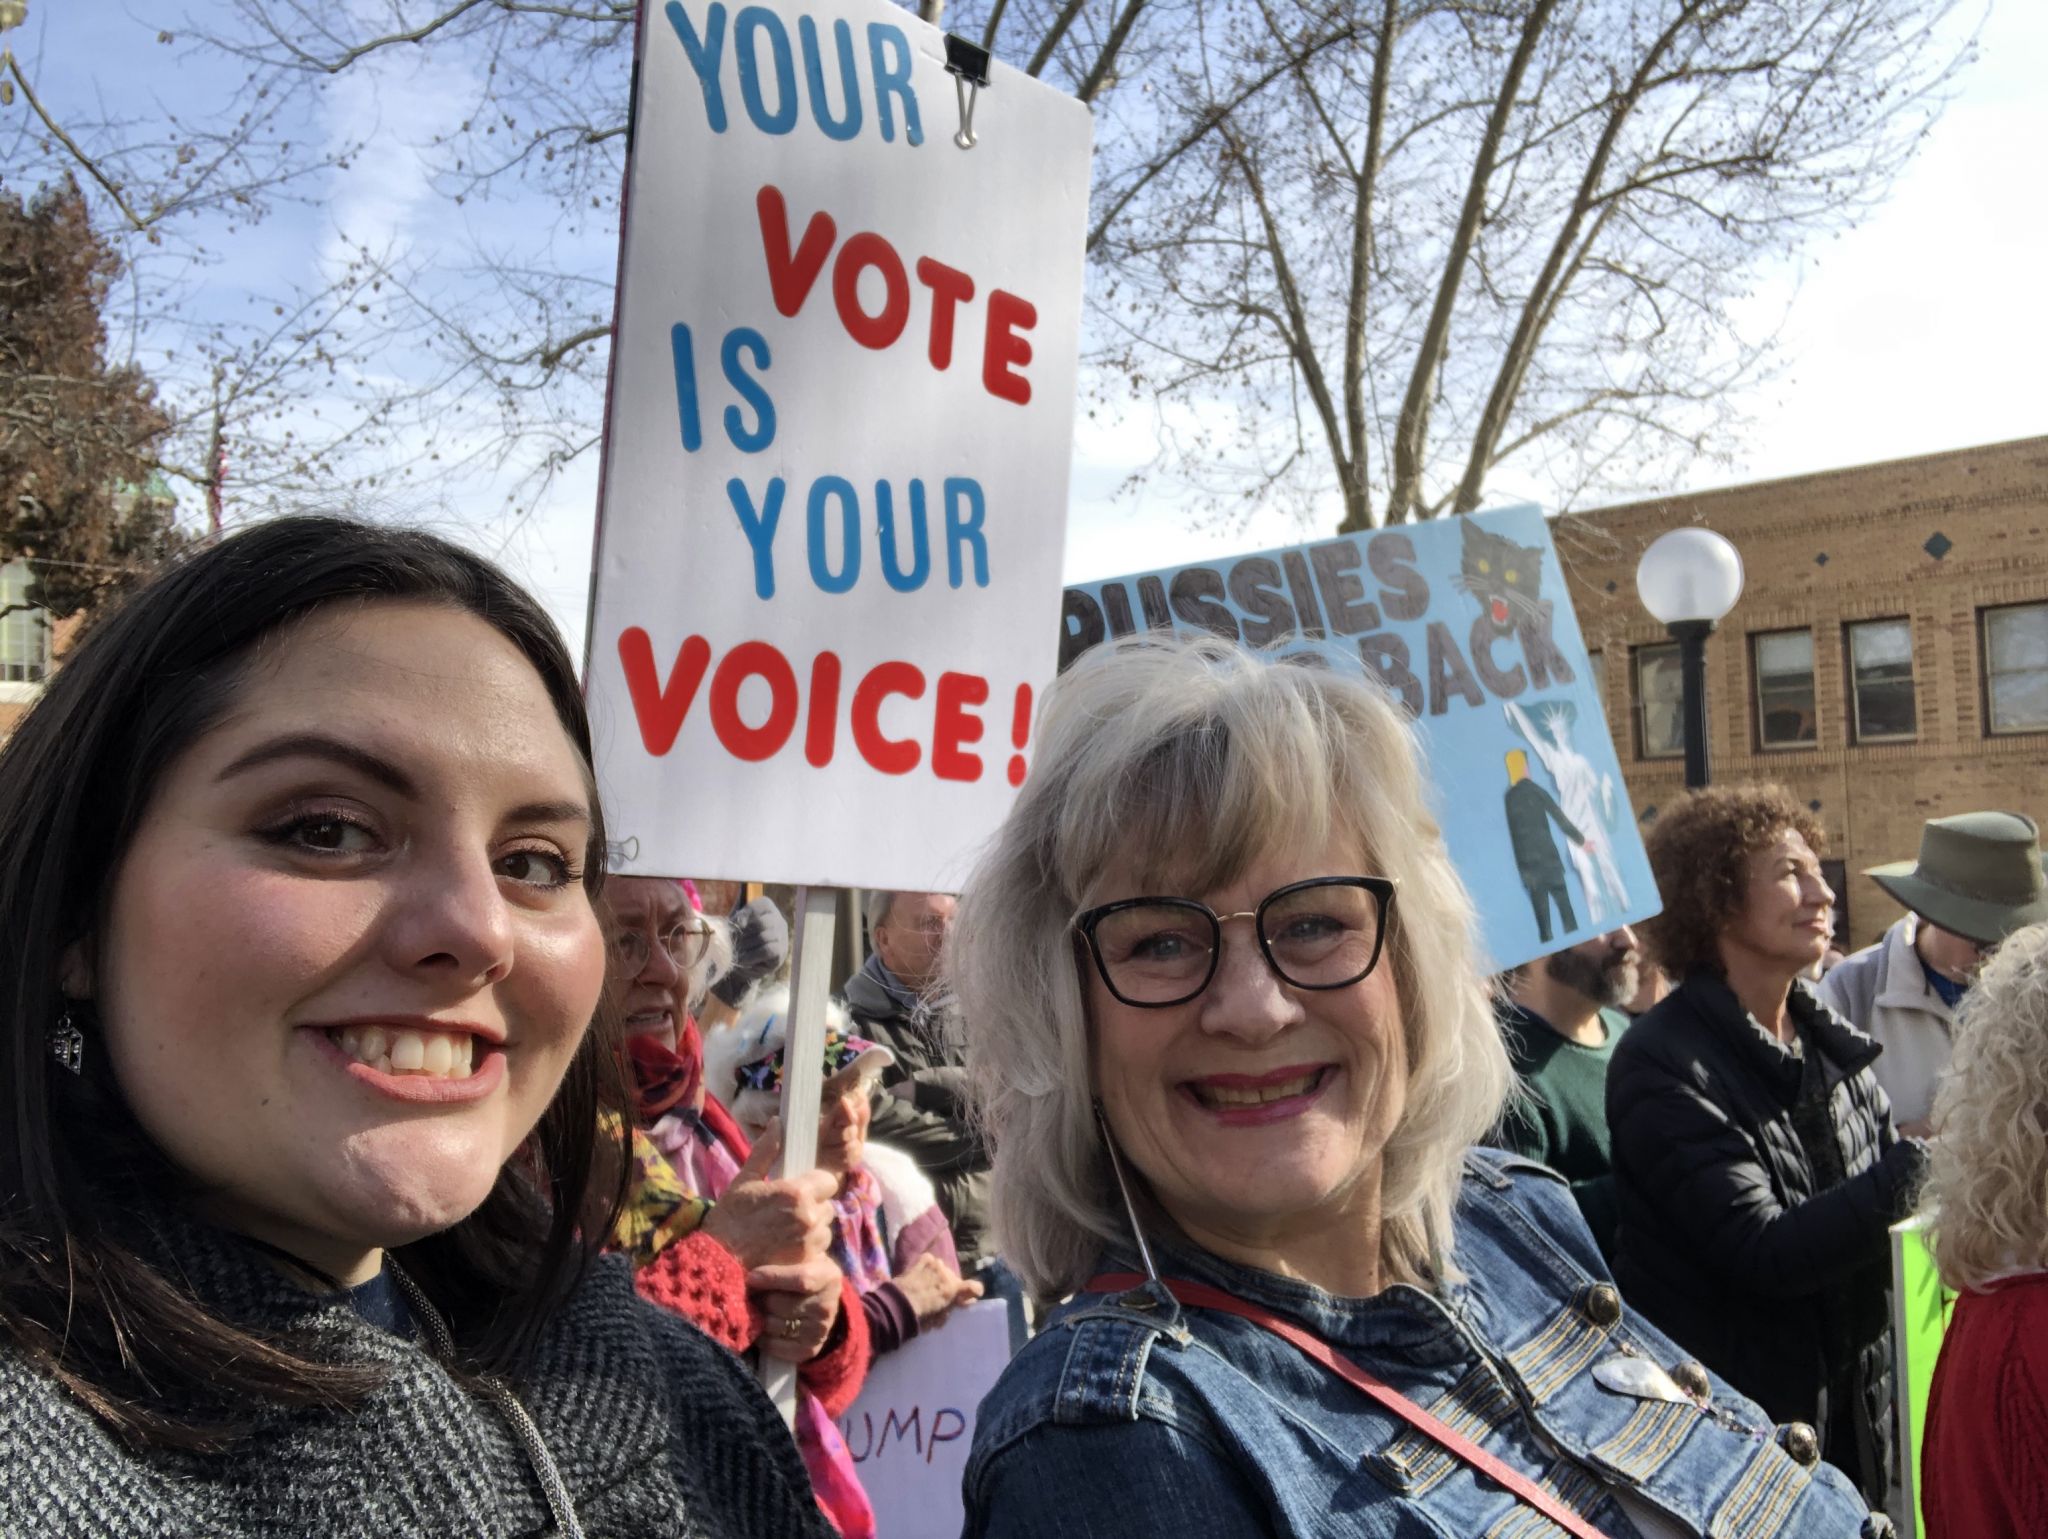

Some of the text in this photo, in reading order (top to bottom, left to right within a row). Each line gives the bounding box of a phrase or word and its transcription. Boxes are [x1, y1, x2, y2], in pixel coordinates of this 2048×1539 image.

[665, 0, 924, 147] YOUR
[756, 184, 1038, 407] VOTE
[671, 321, 777, 453] IS
[726, 475, 990, 600] YOUR
[1056, 532, 1430, 678] PUSSIES
[617, 626, 1033, 788] VOICE!
[1358, 598, 1576, 723] BACK
[837, 1405, 966, 1464] UMP
